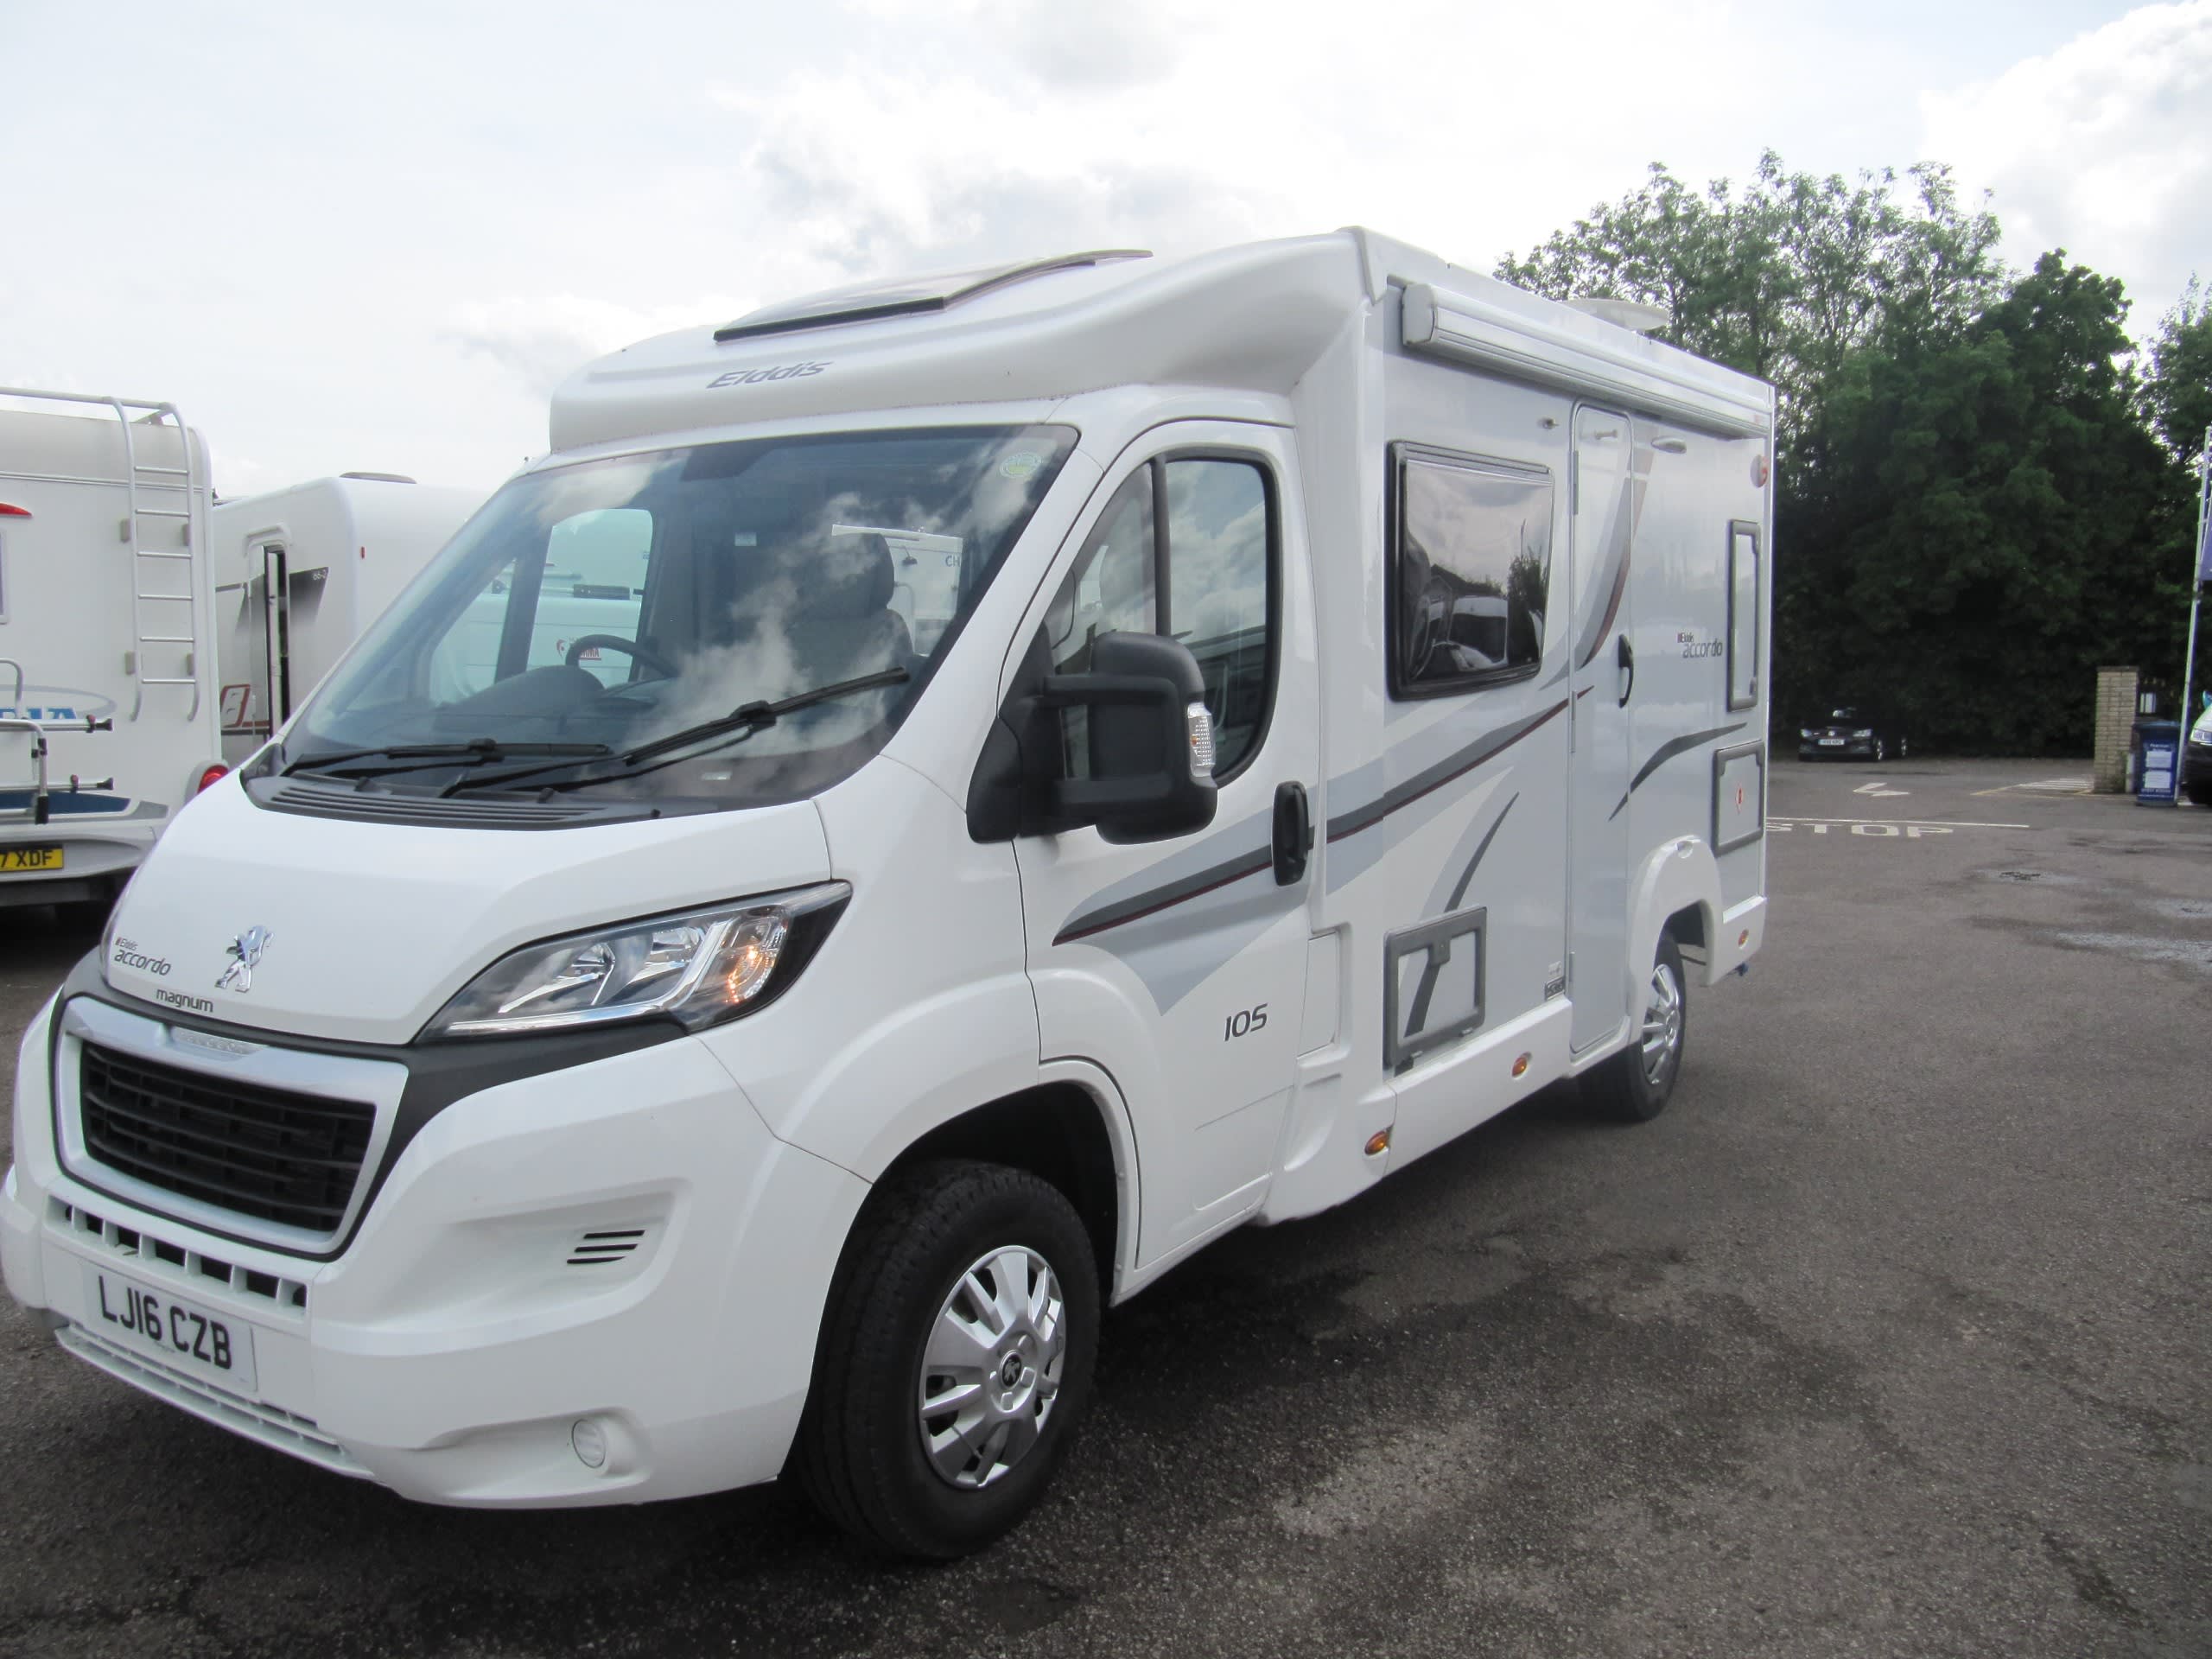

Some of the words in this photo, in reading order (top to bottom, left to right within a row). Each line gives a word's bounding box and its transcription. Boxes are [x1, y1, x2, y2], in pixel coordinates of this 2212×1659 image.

[706, 361, 834, 389] Elddis
[1682, 638, 1723, 658] accordo
[1765, 822, 1953, 837] STOP
[16, 849, 54, 867] XDF
[114, 949, 171, 976] accordo
[156, 988, 213, 1013] magnum
[98, 1274, 162, 1341] LJ16
[169, 1305, 232, 1370] CZB
